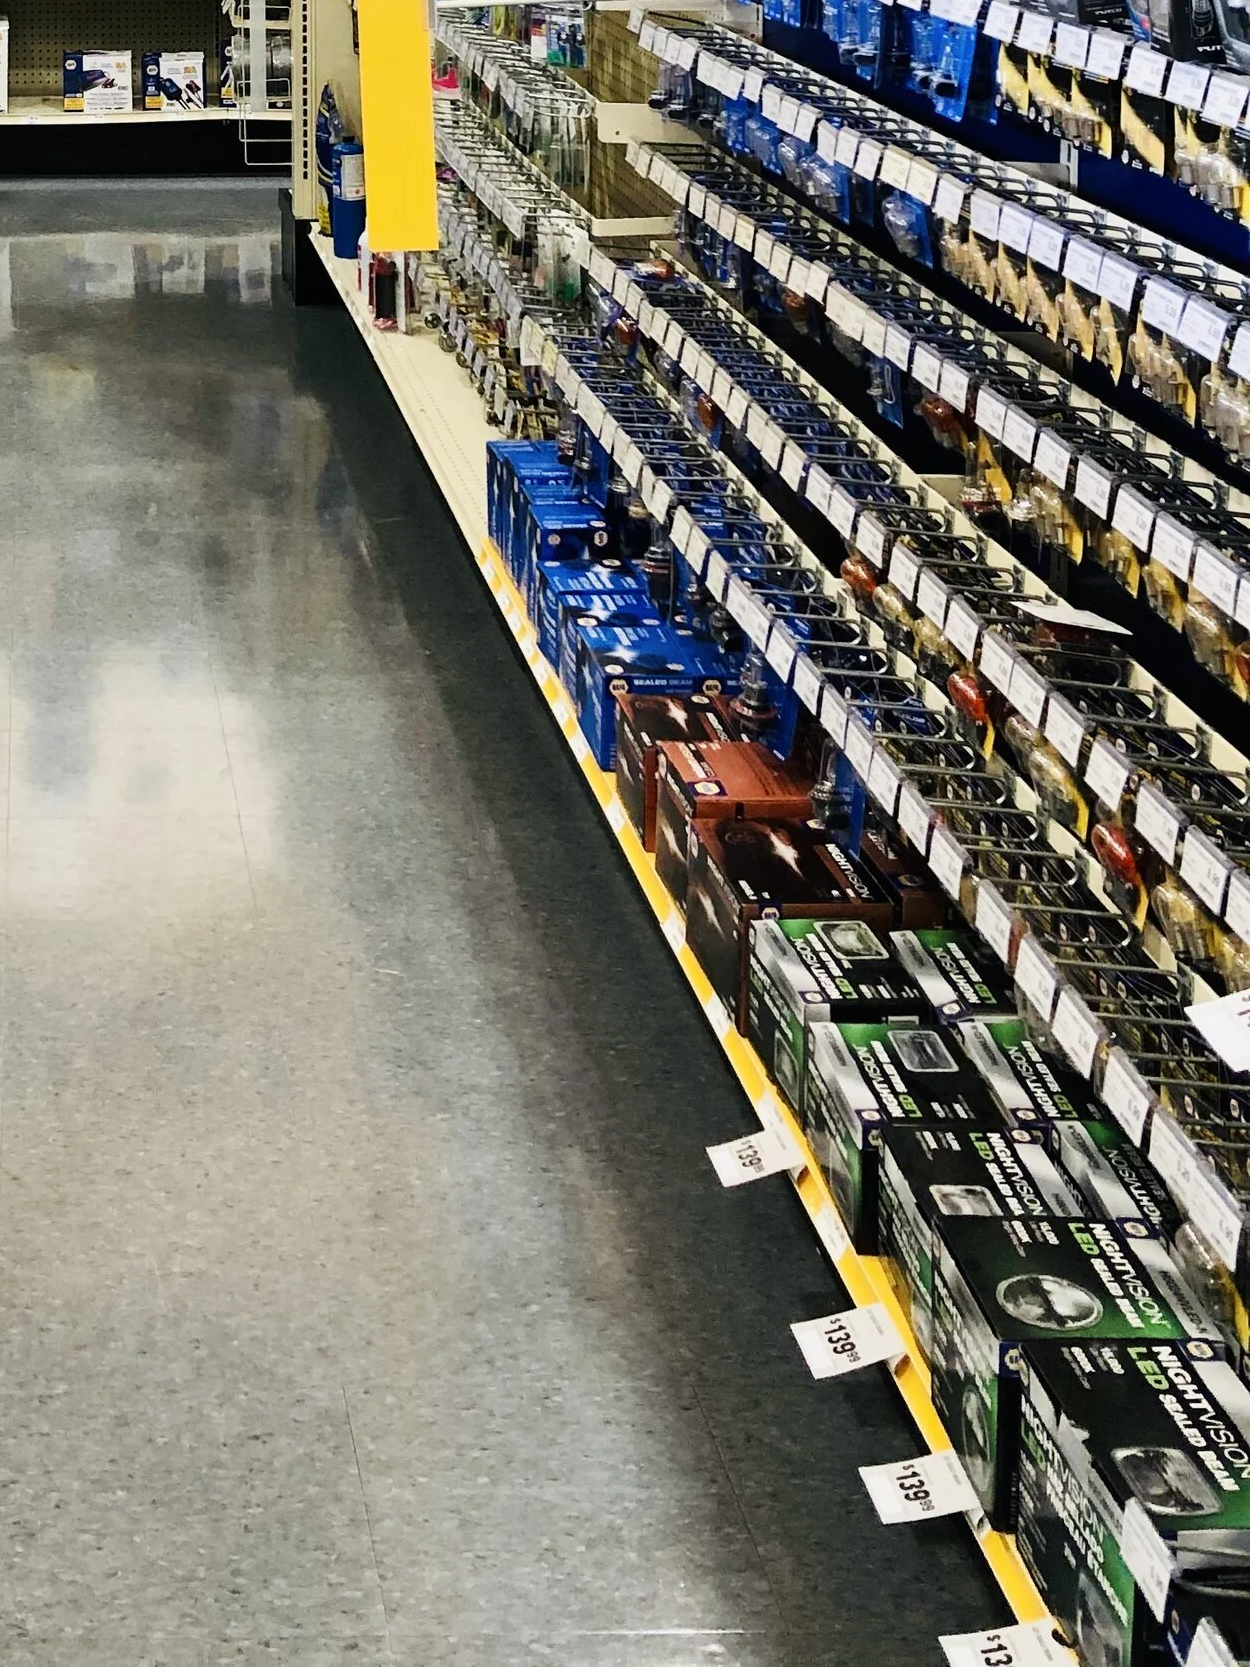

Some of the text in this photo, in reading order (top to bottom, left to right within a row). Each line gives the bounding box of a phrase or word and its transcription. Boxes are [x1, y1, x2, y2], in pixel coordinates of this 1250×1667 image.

[633, 678, 668, 686] SEALED
[825, 843, 874, 901] NIGHTVISION
[789, 936, 843, 1000] NIGHTVISION
[835, 977, 858, 999] LED
[930, 945, 981, 1004] NIGHTVISION
[853, 1043, 905, 1118] NIGHTVISION
[898, 1094, 923, 1117] LED
[1002, 1045, 1062, 1118] NIGHTVISION
[1053, 1094, 1079, 1118] LED
[969, 1132, 995, 1161] LED
[986, 1132, 1048, 1216] NIGHTVISION
[1068, 1222, 1100, 1256] LED
[1088, 1222, 1169, 1326] NIGHTVISION
[1127, 1347, 1240, 1491] LED SEALED BEAM
[1152, 1346, 1250, 1479] NIGHTVISION
